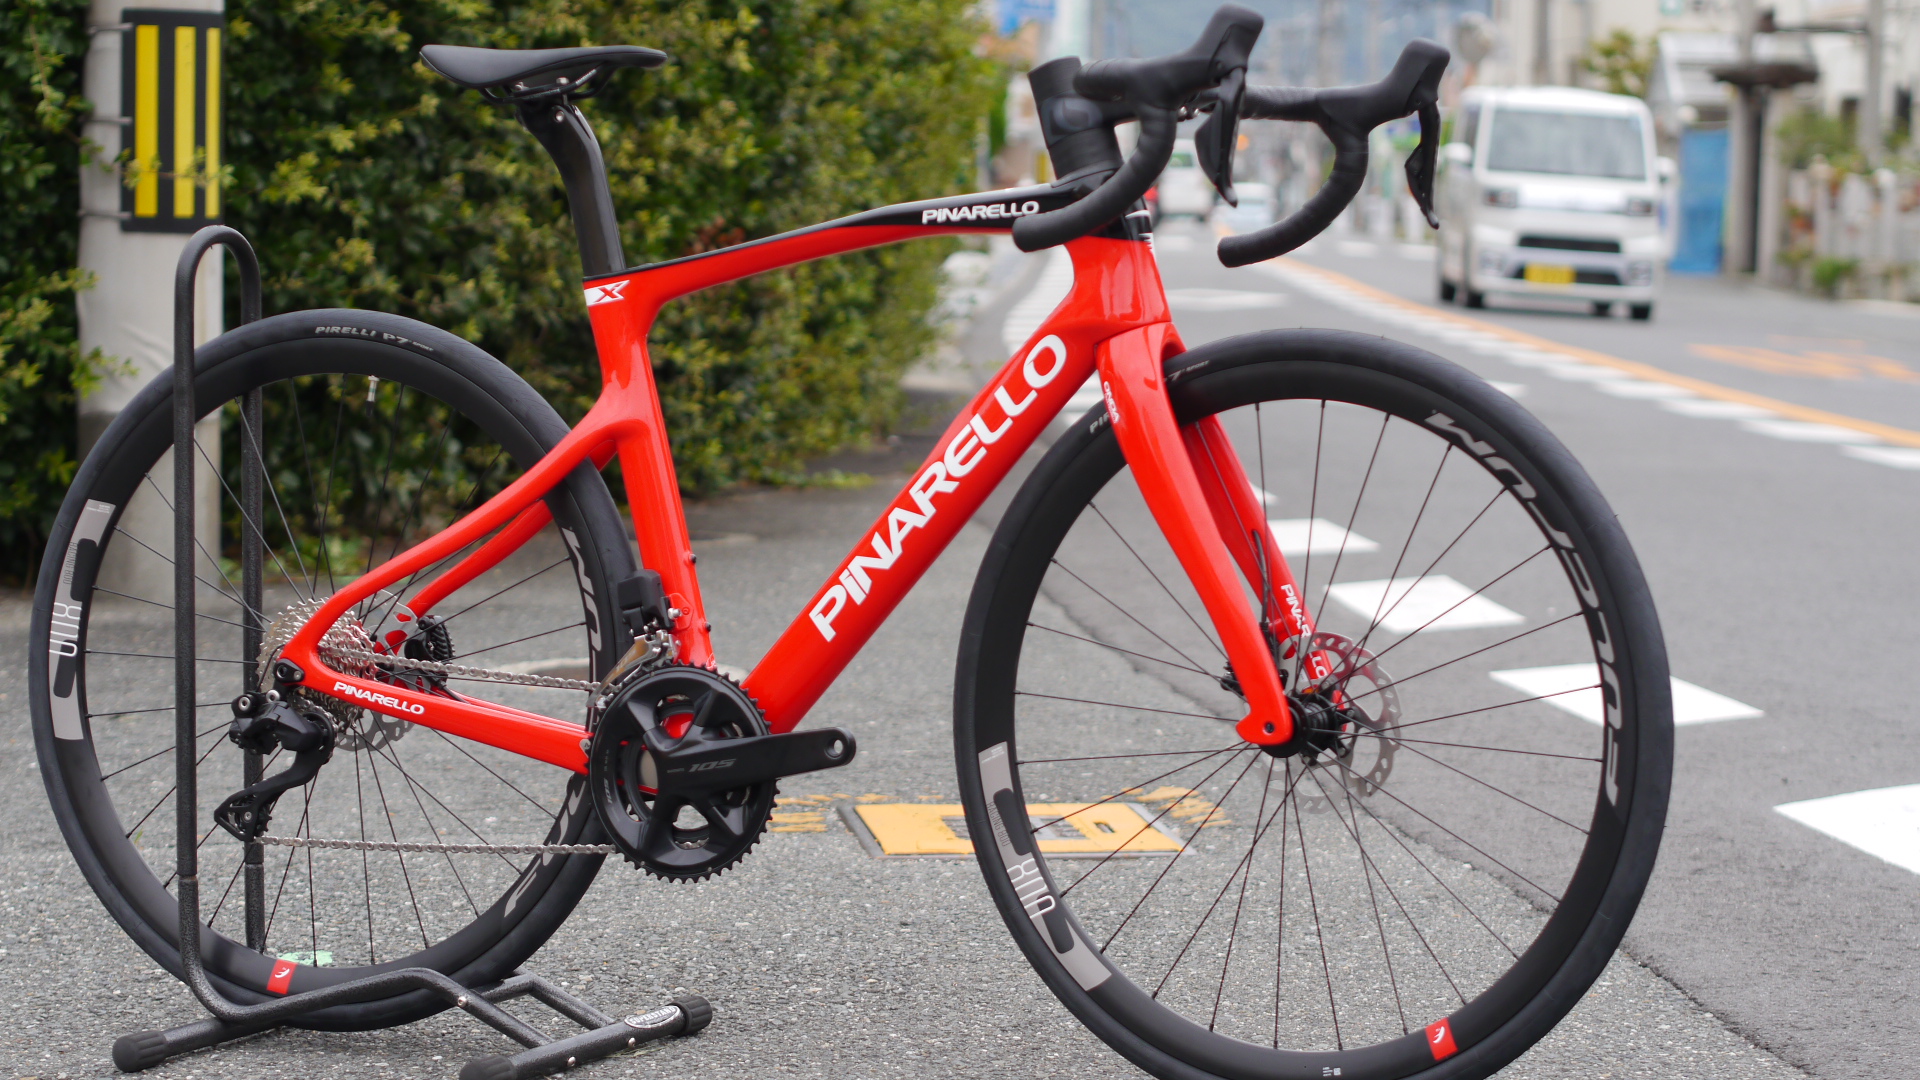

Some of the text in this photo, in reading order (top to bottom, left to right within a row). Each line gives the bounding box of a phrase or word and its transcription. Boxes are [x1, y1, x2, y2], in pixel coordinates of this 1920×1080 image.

[921, 200, 1040, 225] PINARELLO
[315, 326, 377, 337] PIRELLI
[383, 332, 409, 344] P7
[808, 334, 1067, 642] PINARELLO
[1281, 584, 1328, 679] PINARLO
[333, 681, 425, 715] PINARELLO
[688, 758, 736, 773] 105
